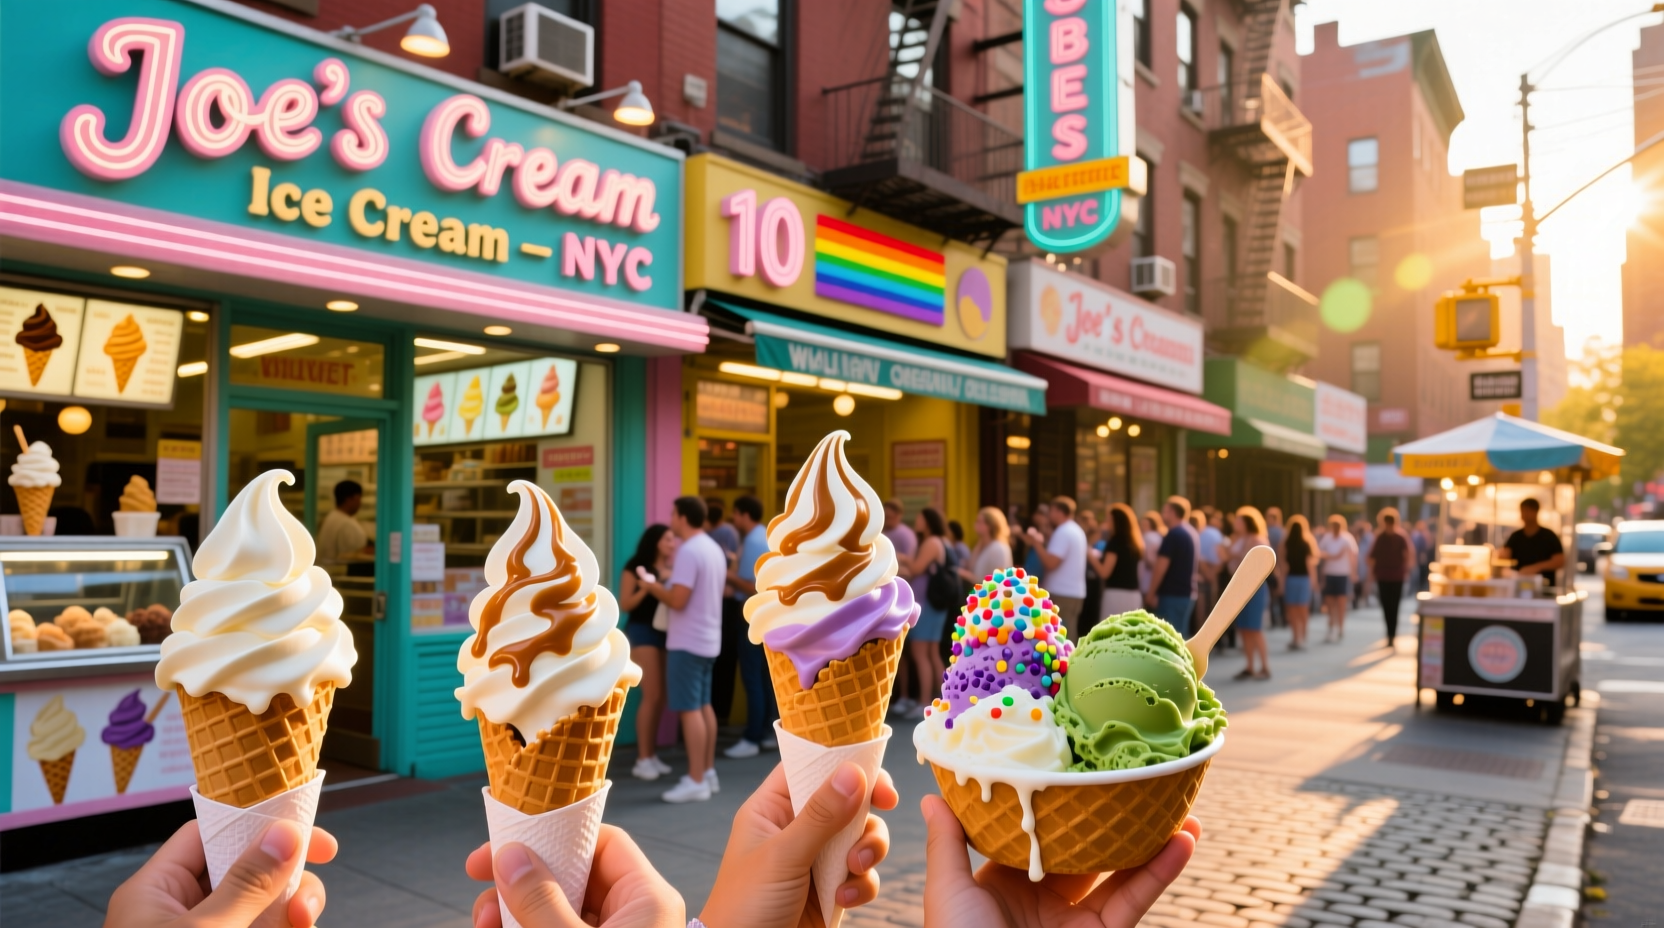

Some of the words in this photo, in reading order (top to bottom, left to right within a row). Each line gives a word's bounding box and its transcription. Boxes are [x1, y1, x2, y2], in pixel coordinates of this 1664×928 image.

[59, 17, 389, 181] Joe's
[420, 94, 660, 233] Cream
[248, 166, 333, 227] Ice
[348, 188, 509, 263] Cream
[561, 232, 653, 291] NYC
[720, 188, 806, 288] 10
[1042, 199, 1099, 231] NYC
[1066, 291, 1124, 345] Joe's
